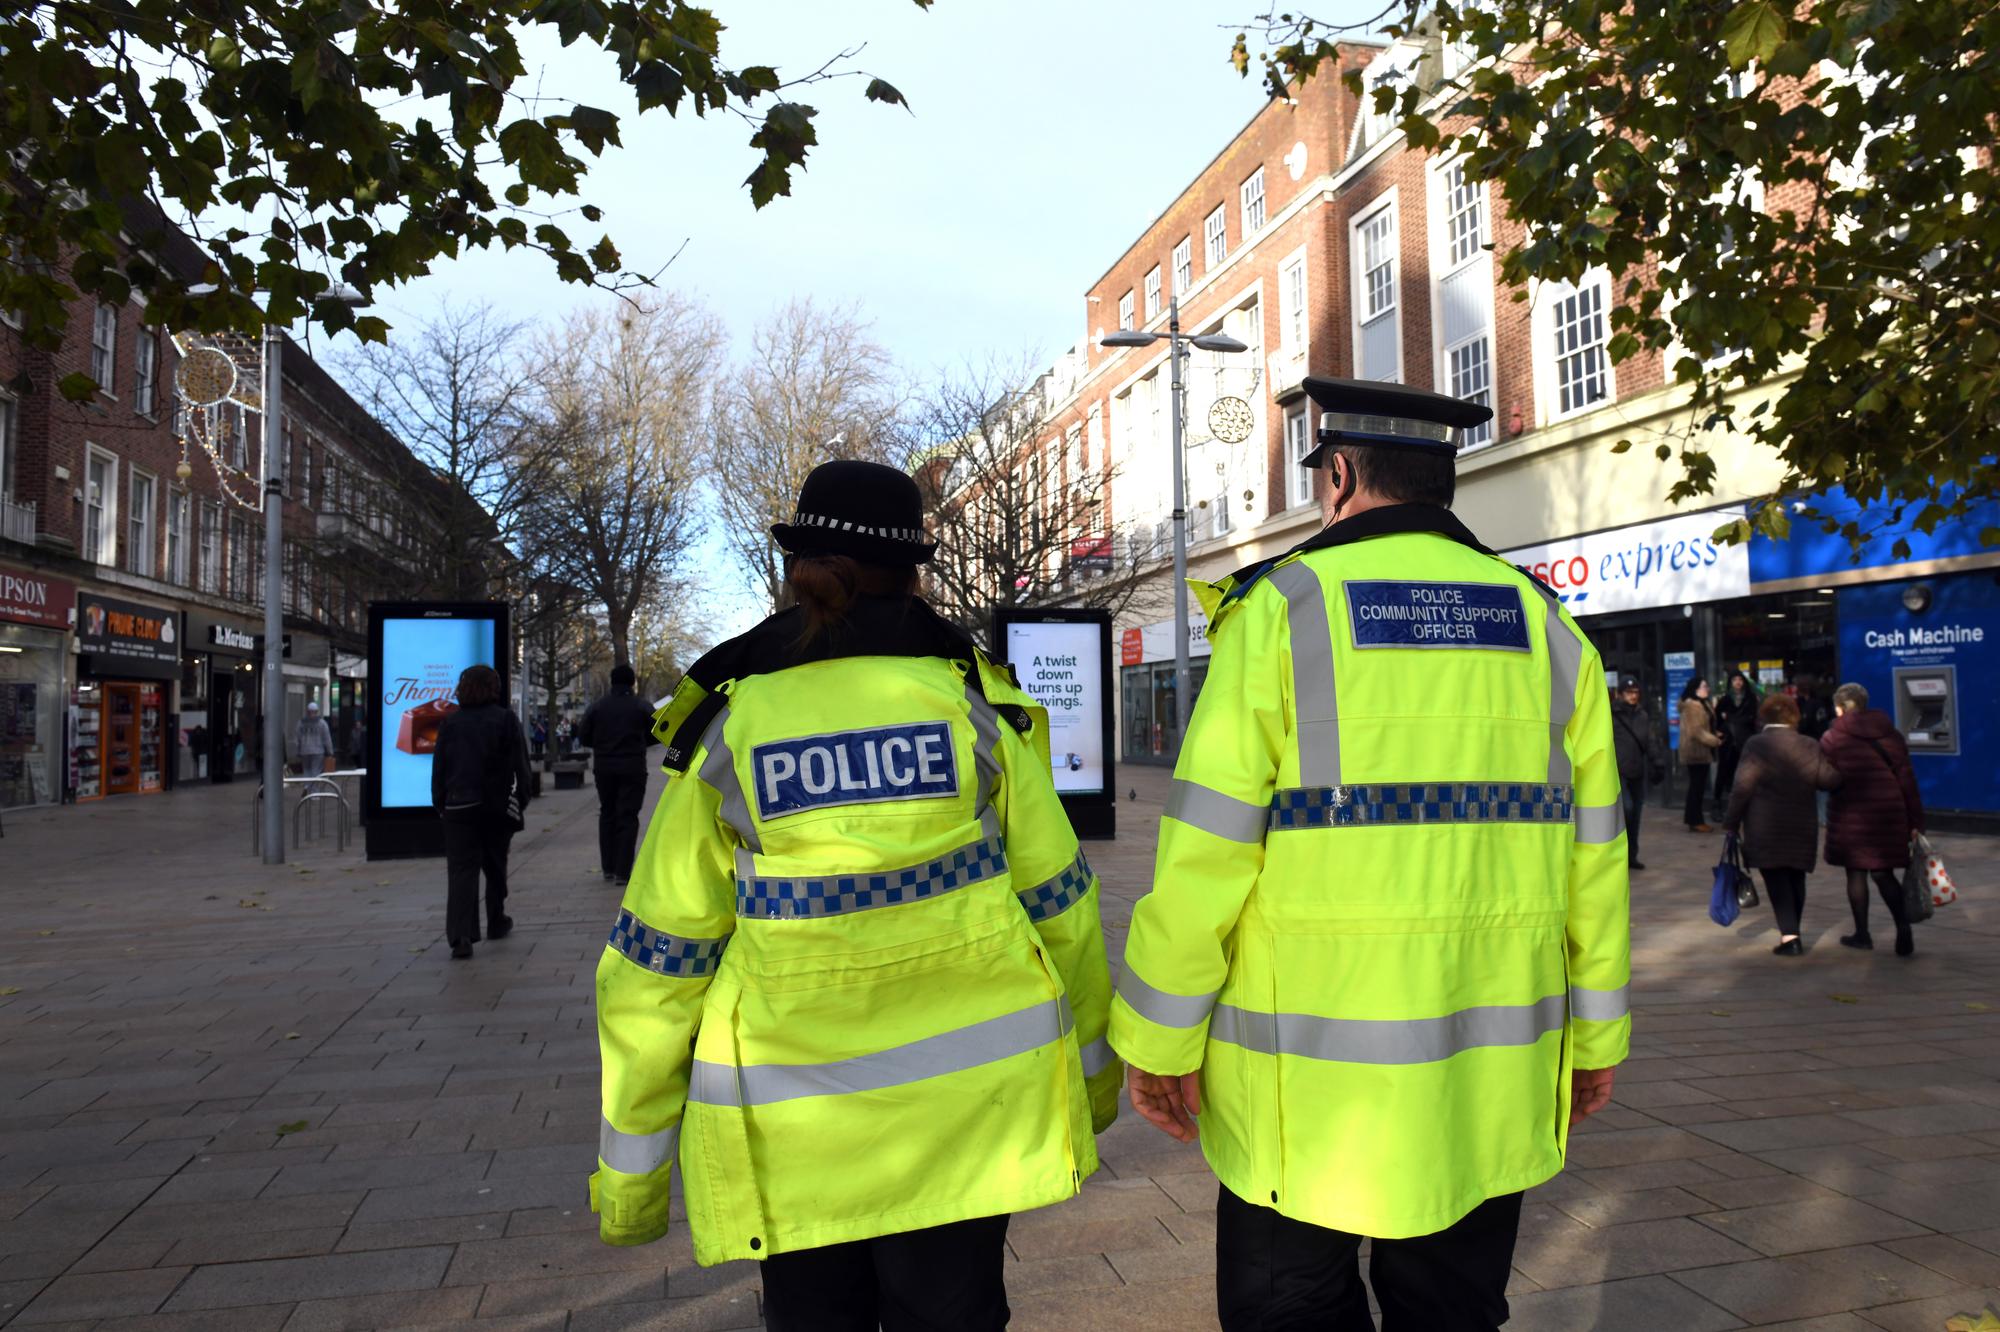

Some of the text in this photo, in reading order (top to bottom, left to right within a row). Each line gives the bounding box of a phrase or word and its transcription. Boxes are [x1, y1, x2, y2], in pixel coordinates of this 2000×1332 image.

[1524, 536, 1719, 589] SCO express
[0, 574, 47, 607] PSON
[1410, 588, 1464, 604] POLICE
[1359, 604, 1518, 624] COMMUNITY SUPPORT
[1413, 623, 1476, 639] OFFICER
[1865, 624, 1984, 648] Cash Machine
[1032, 655, 1077, 667] A twist
[1036, 669, 1073, 680] down
[1028, 684, 1083, 696] turns up
[1036, 696, 1083, 710] avings.
[761, 733, 948, 804] POLICE
